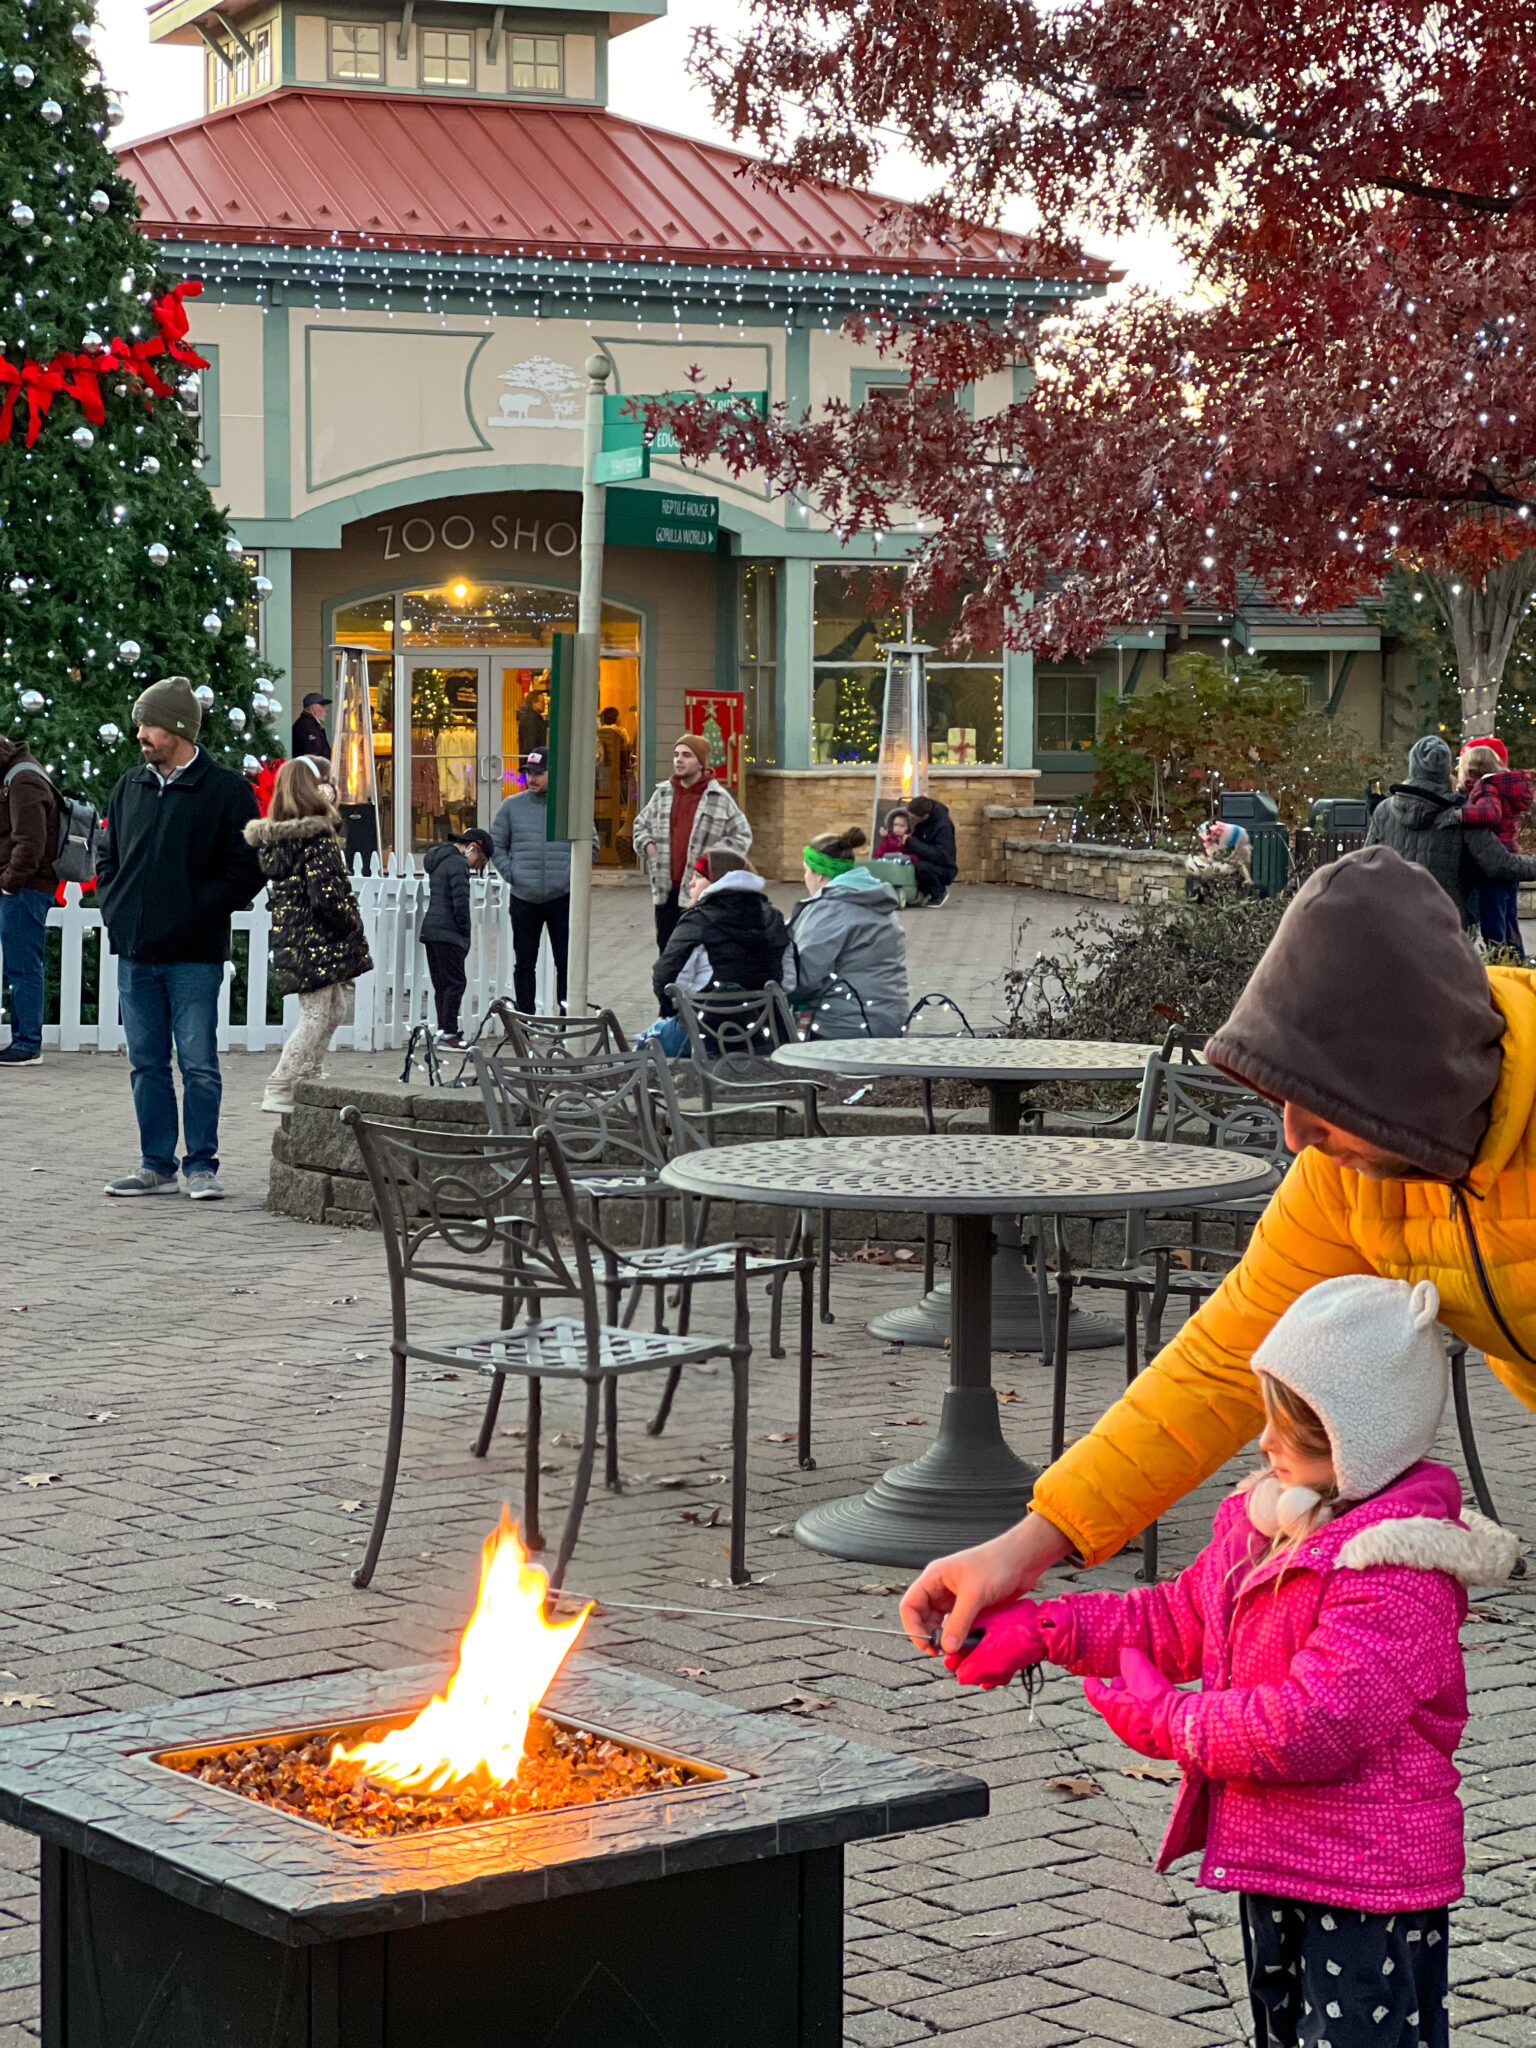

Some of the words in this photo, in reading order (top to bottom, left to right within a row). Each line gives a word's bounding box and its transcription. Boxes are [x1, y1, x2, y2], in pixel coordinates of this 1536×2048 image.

[662, 499, 685, 516] REPTILE
[686, 502, 708, 517] HOUSE
[376, 515, 475, 560] ZOO
[490, 514, 578, 557] SHO
[655, 527, 682, 543] GORILLA
[682, 529, 706, 545] WORLD
